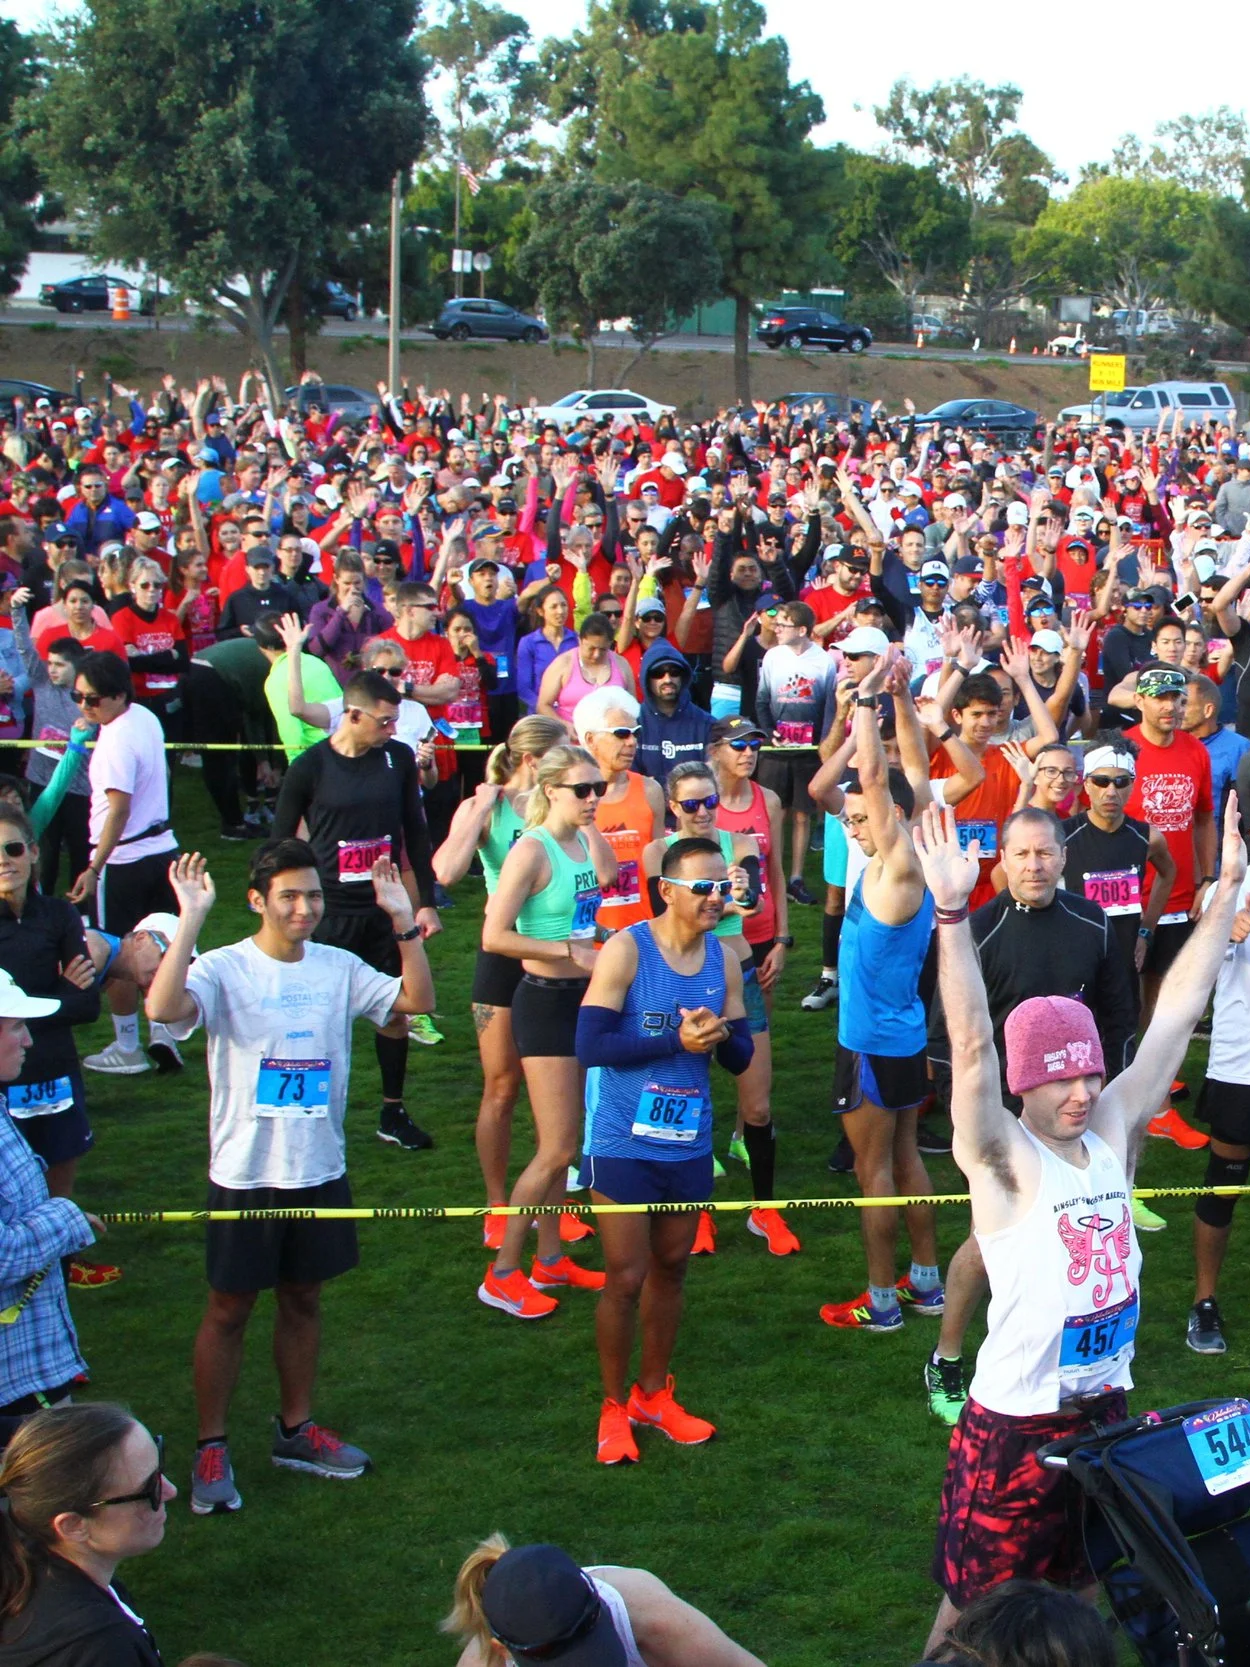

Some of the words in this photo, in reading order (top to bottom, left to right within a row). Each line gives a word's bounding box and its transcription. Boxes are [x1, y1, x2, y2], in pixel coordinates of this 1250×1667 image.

[1090, 880, 1131, 902] 2603
[277, 1072, 305, 1101] 73
[649, 1096, 688, 1124] 862
[1053, 1196, 1086, 1213] AINSLEY'S
[1075, 1318, 1121, 1358] 457
